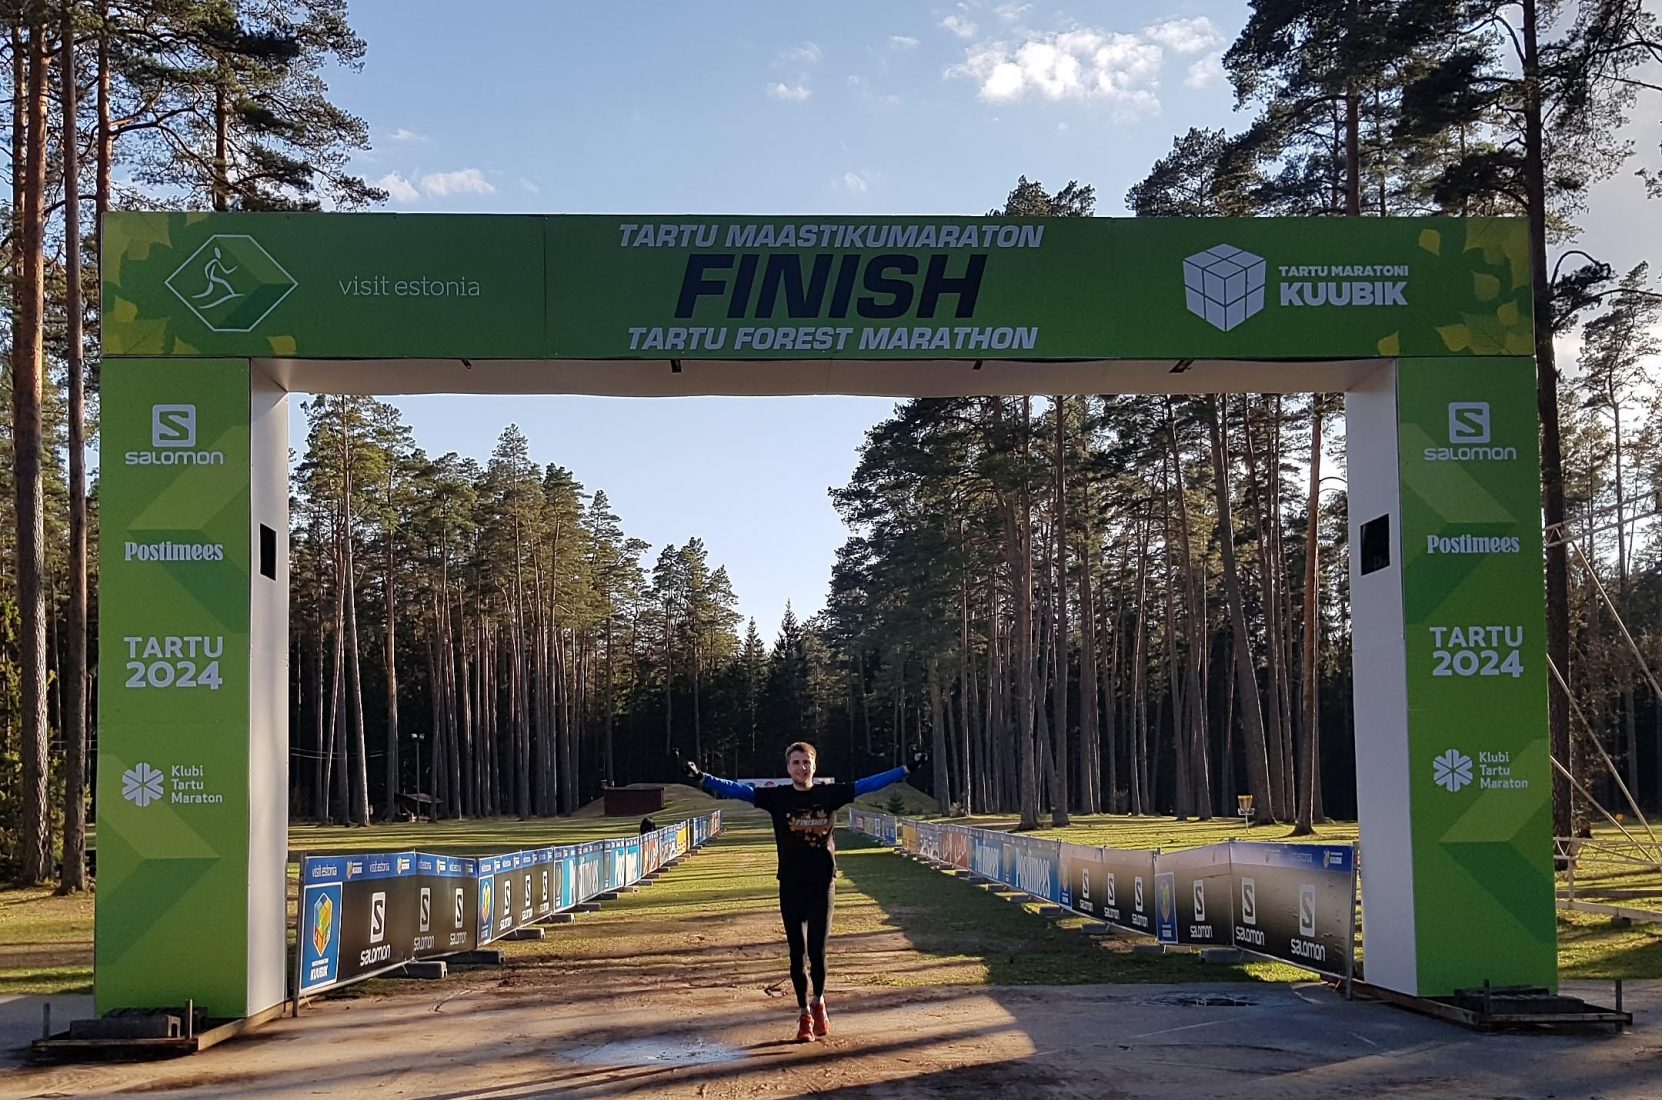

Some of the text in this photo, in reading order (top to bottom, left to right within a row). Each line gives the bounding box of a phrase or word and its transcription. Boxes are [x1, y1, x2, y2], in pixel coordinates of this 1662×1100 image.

[619, 224, 1044, 248] TARTU MAASTIKUMARATON
[1279, 265, 1409, 277] TARTU MARATONI
[339, 275, 480, 297] visit estonia
[674, 254, 988, 318] FINISH
[1279, 281, 1409, 306] KUUBIK
[628, 327, 1039, 350] TARTU FOREST MARATHON
[124, 541, 224, 561] Postimees
[1426, 534, 1520, 553] Postimees
[1429, 626, 1523, 647] TARTU
[123, 636, 223, 658] TARTU
[1432, 650, 1524, 677] 2024
[125, 661, 223, 689] 2024
[1479, 752, 1510, 763] Klubi
[171, 765, 204, 777] Klubi
[1479, 765, 1510, 776] Tartu
[171, 779, 204, 790] Tartu
[1480, 778, 1529, 789] Maraton
[171, 792, 223, 804] Maraton
